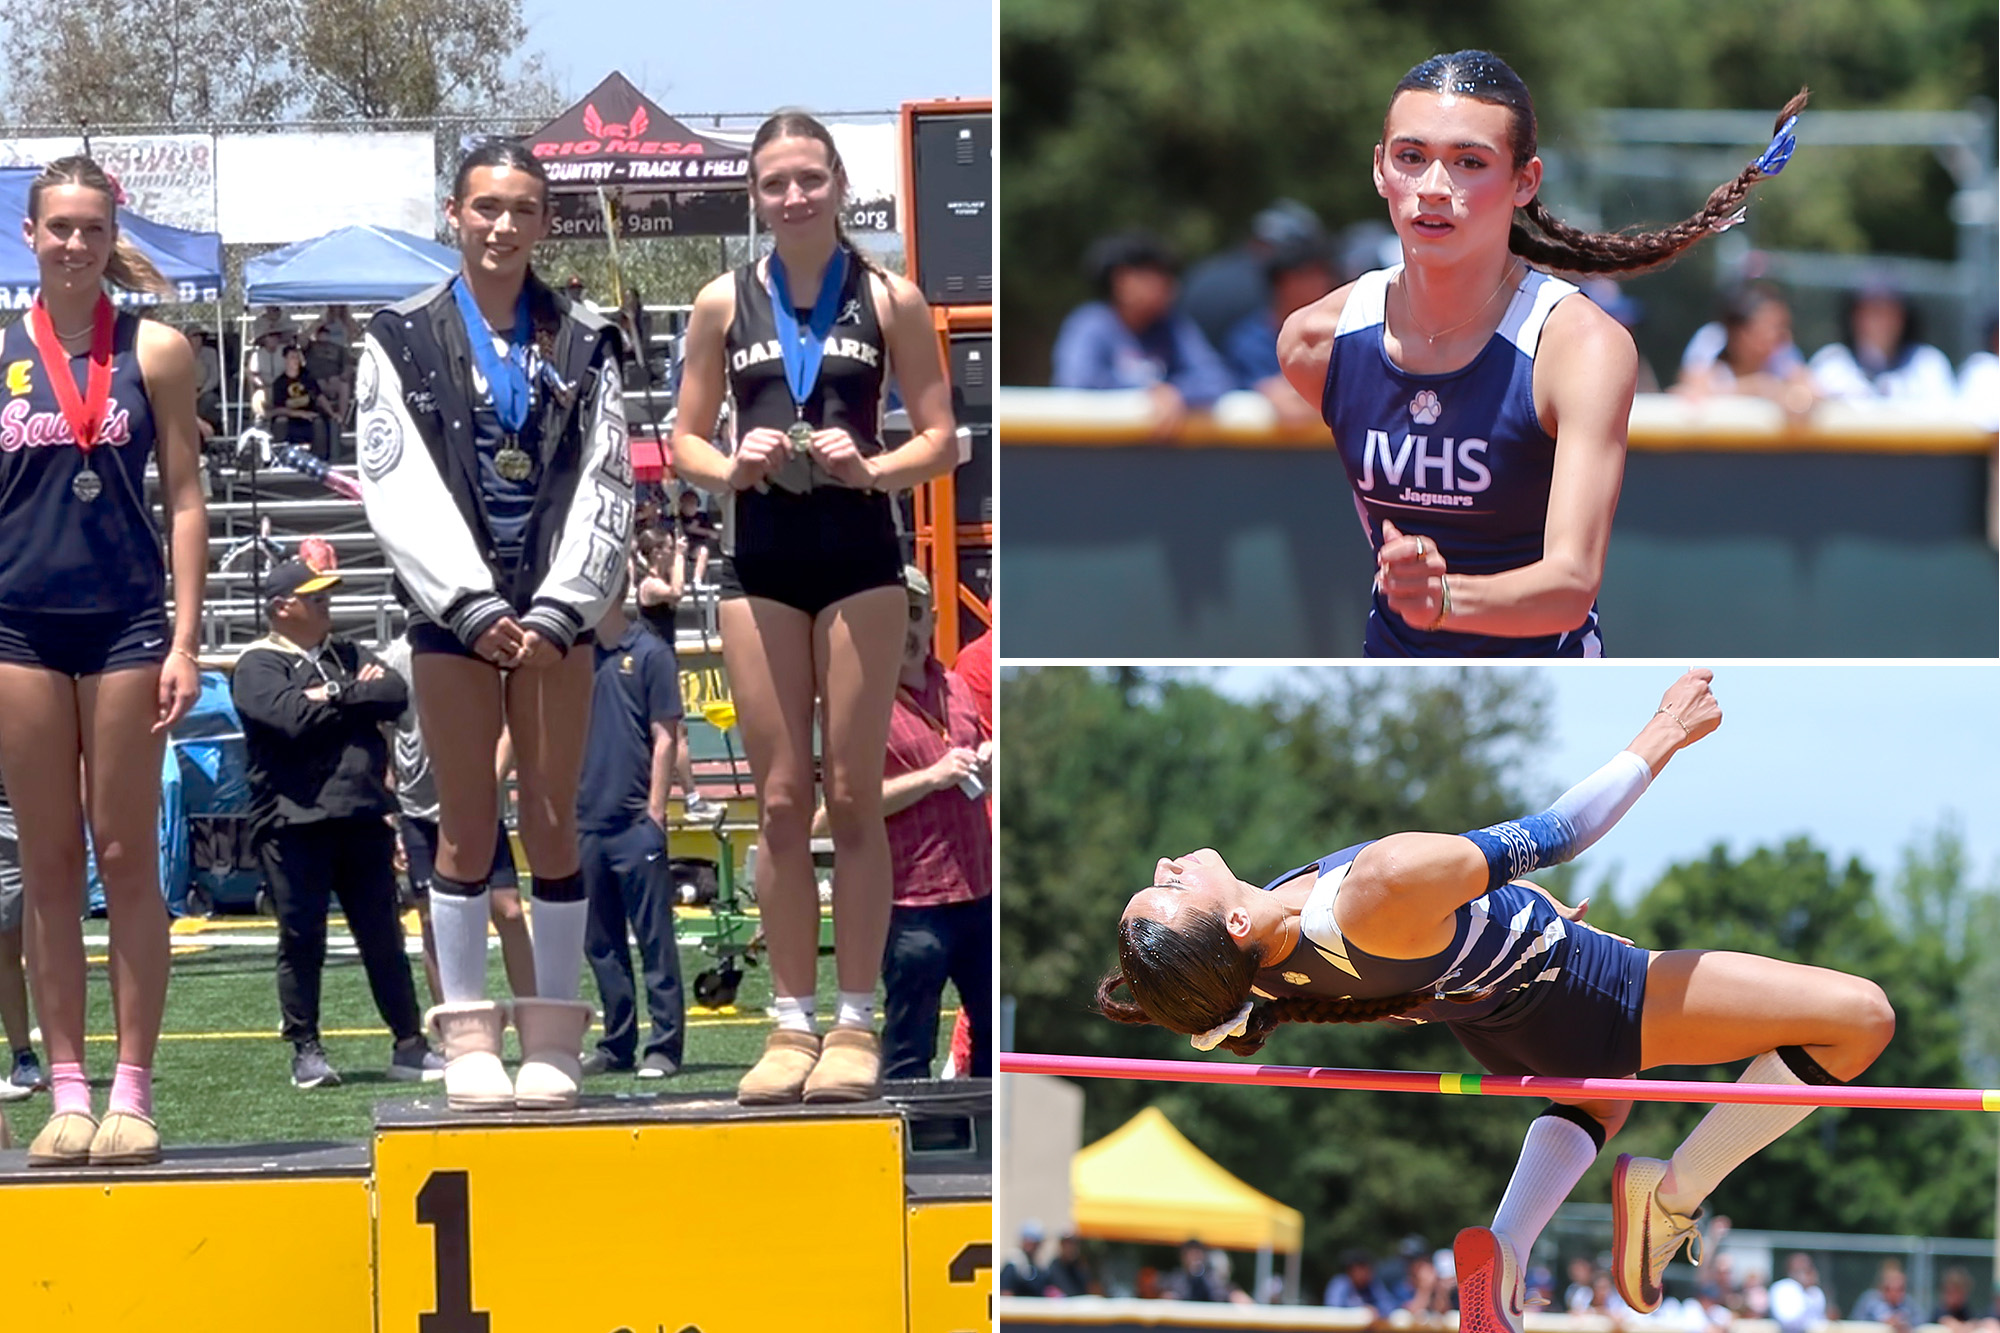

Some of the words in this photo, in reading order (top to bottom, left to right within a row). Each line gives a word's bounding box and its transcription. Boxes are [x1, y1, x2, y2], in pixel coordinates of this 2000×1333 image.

[532, 141, 601, 157] RIO
[605, 139, 704, 155] MESA
[628, 161, 682, 178] TRACK
[686, 160, 698, 177] &
[703, 160, 749, 176] FIELD
[628, 215, 673, 232] 9am
[822, 336, 879, 368] ARK
[1357, 429, 1492, 493] JVHS
[1400, 488, 1473, 506] Jaguars
[417, 1171, 490, 1333] 1
